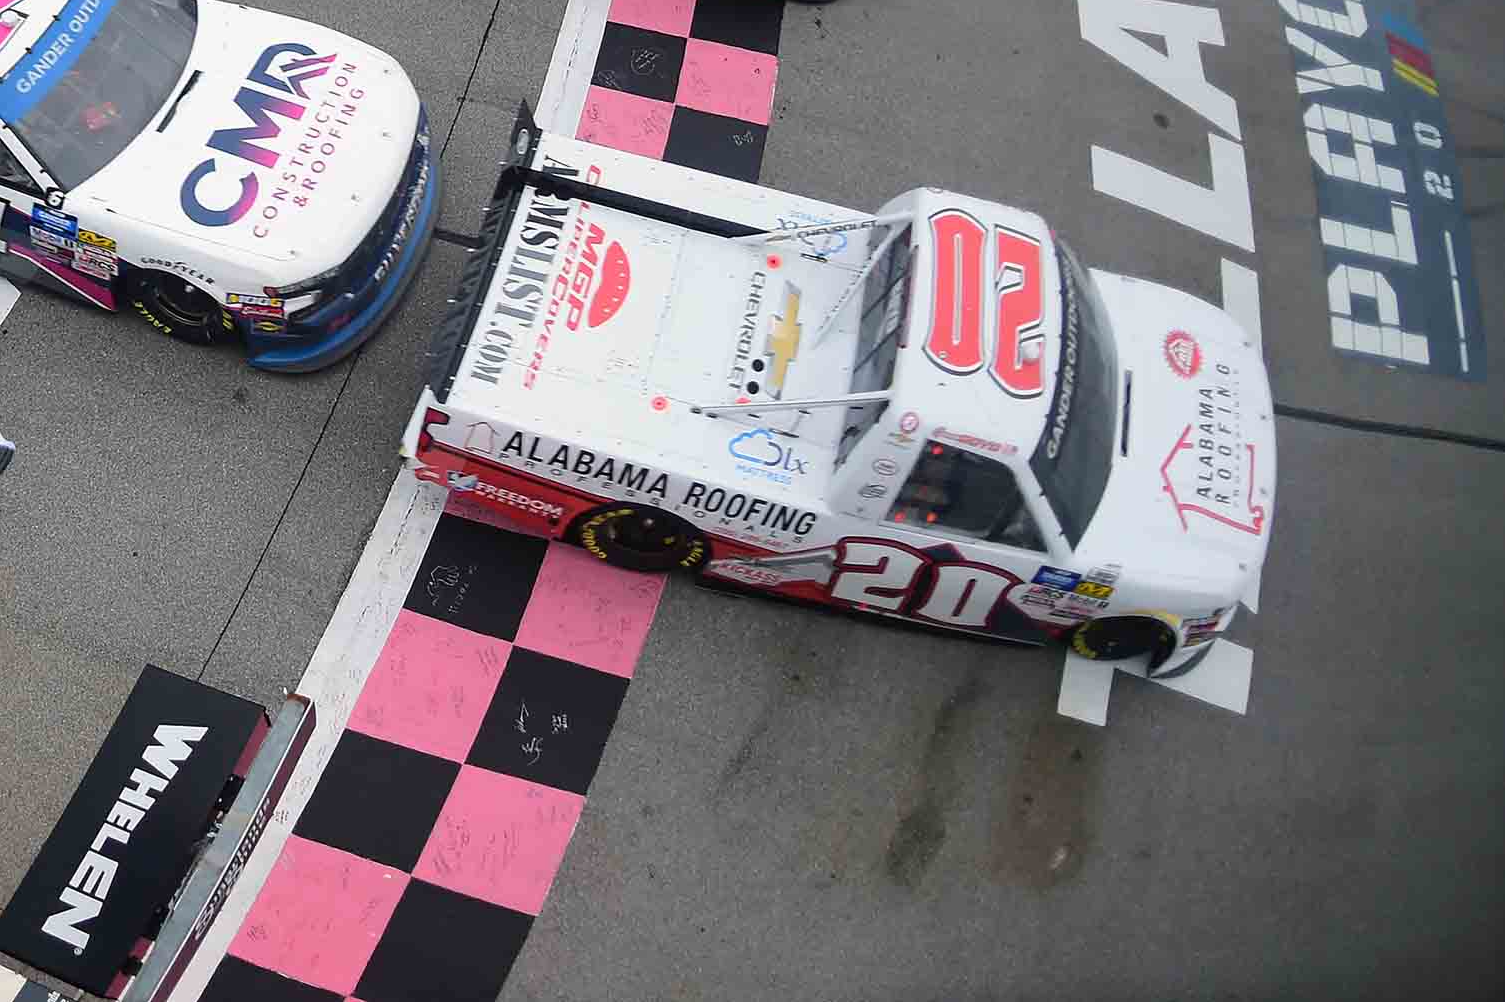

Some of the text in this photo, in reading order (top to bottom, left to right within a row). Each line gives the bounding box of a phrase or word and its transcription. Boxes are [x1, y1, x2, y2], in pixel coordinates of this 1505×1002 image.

[15, 33, 73, 95] GANDER
[179, 42, 338, 228] CMR
[253, 61, 358, 239] CONSTRUCTION
[303, 87, 366, 193] ROOFING
[140, 256, 216, 285] GOODYEAR
[470, 154, 579, 385] AMSLIST.COM
[566, 221, 606, 332] MGP
[922, 207, 1046, 400] 20
[501, 431, 817, 536] ALABAMA ROOFING
[1196, 388, 1215, 501] ALABAMA
[1214, 363, 1233, 505] ROOFING
[477, 481, 564, 517] FREEDOM
[498, 452, 805, 544] PROFESSIONALS
[831, 535, 1025, 630] 20
[41, 723, 209, 950] WHELEN
